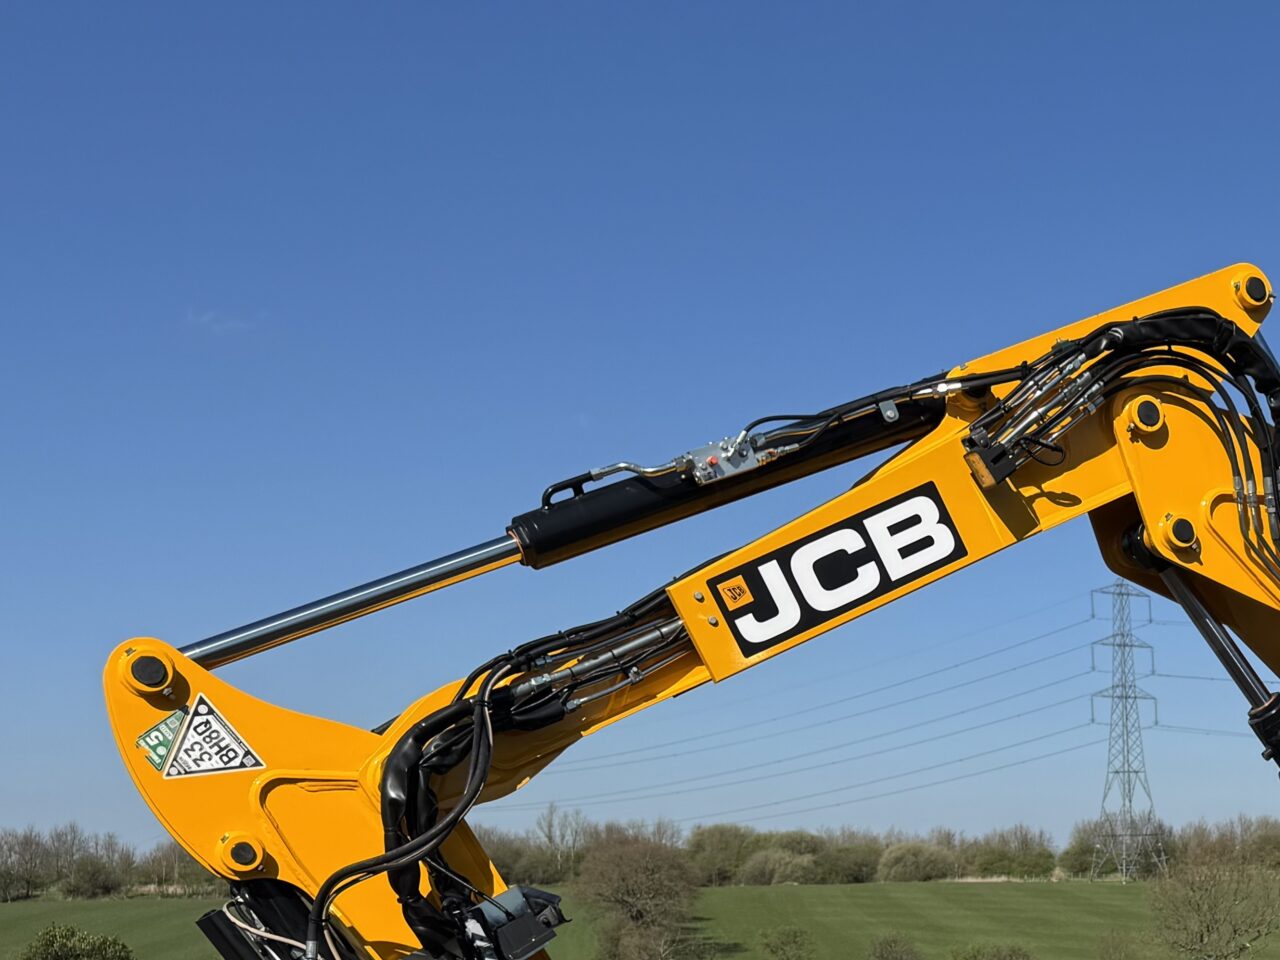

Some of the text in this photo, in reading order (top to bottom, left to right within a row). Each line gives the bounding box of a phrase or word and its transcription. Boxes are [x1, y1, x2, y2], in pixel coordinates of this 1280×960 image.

[734, 495, 956, 643] JCB
[564, 574, 593, 591] X12
[726, 585, 745, 601] JCB
[148, 730, 164, 746] 5
[193, 718, 240, 766] BH8Q
[183, 741, 213, 768] 33
